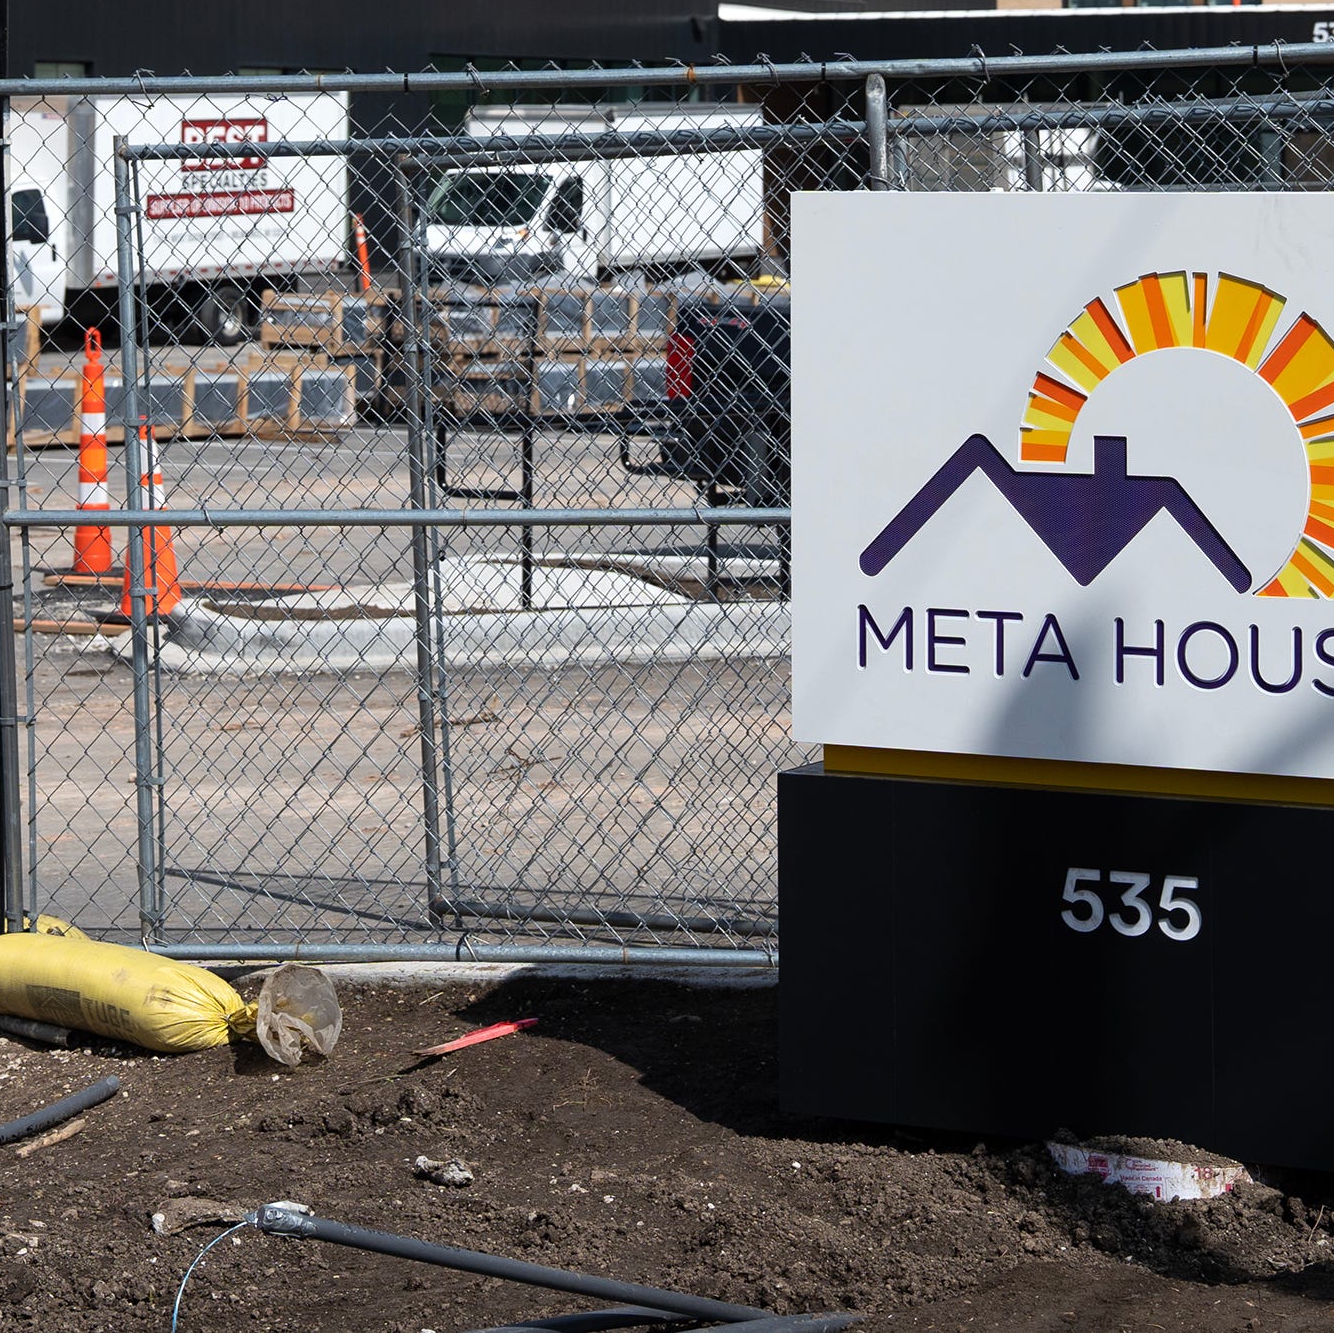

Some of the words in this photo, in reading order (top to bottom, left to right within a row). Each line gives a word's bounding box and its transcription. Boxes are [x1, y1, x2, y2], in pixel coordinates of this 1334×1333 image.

[183, 124, 266, 166] BEST
[182, 172, 267, 188] SPECIALTIES
[856, 604, 1080, 681] META
[1061, 868, 1202, 941] 535
